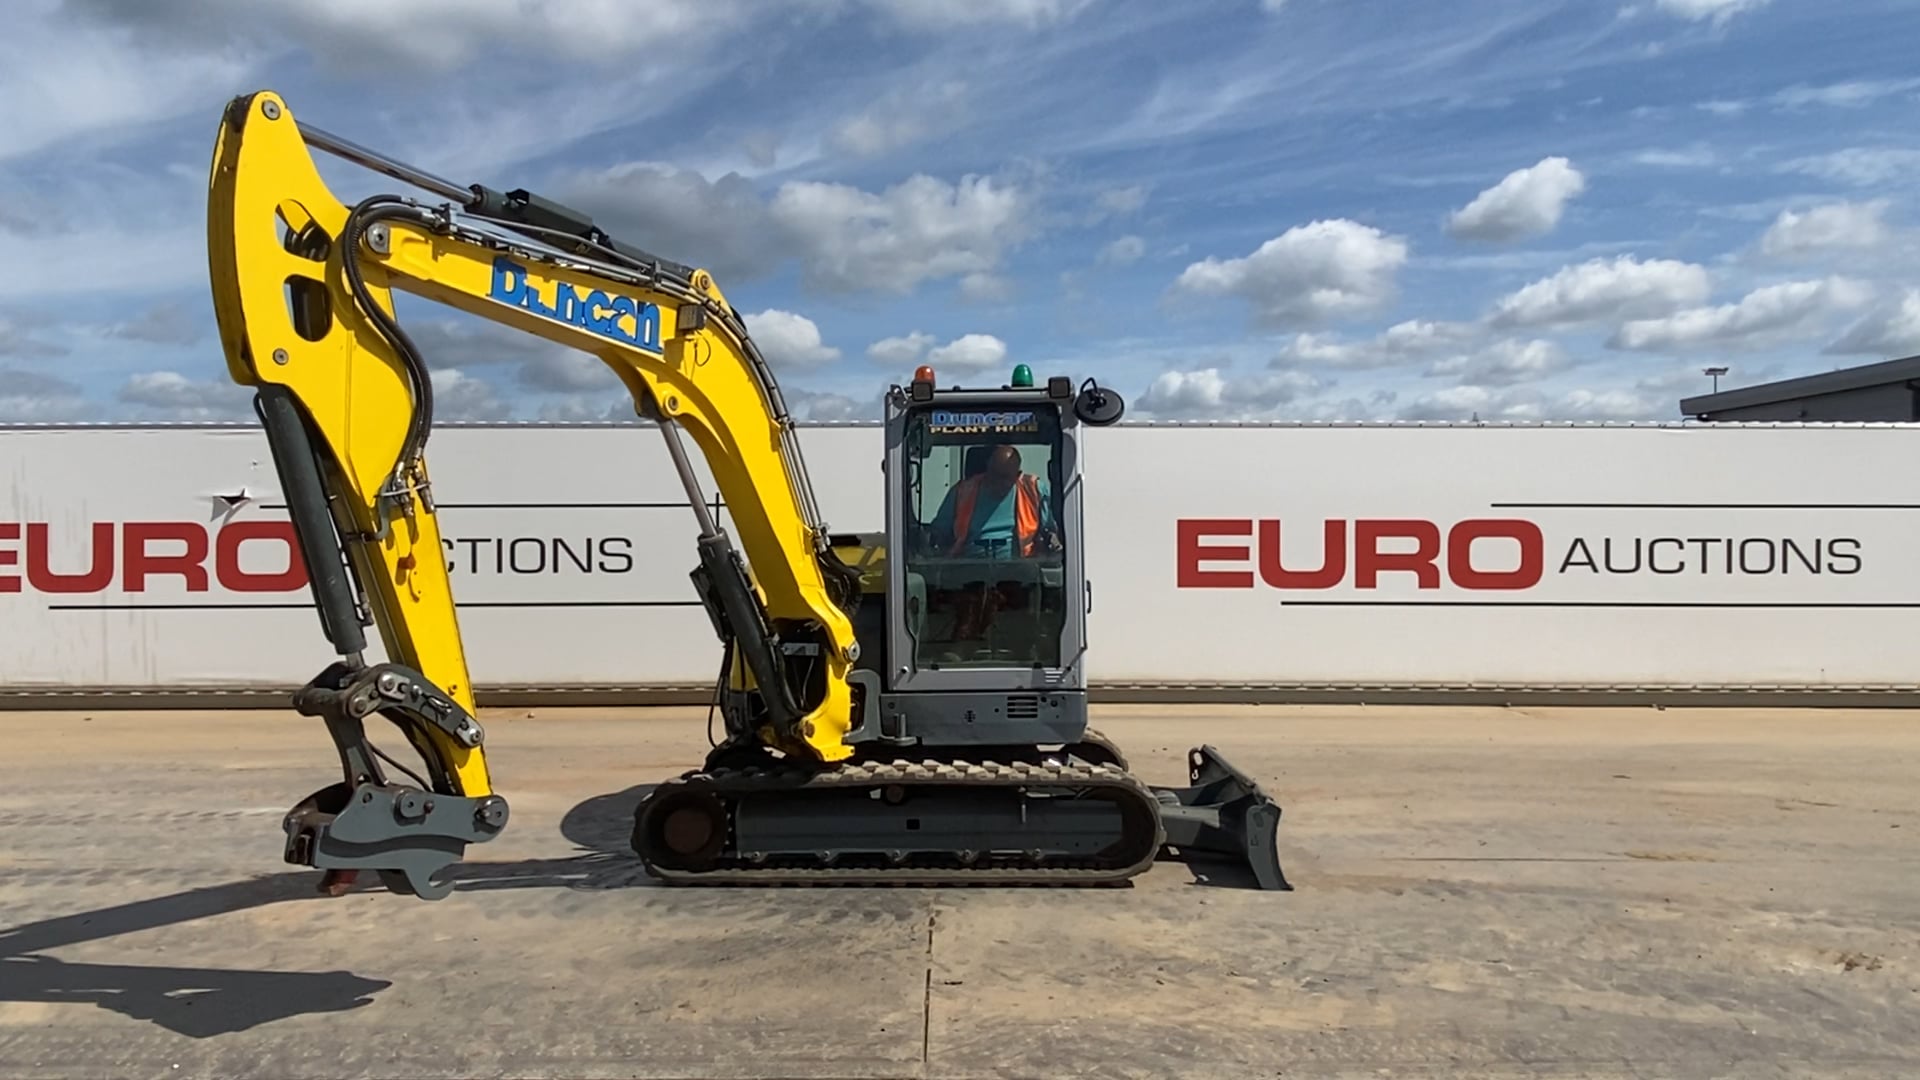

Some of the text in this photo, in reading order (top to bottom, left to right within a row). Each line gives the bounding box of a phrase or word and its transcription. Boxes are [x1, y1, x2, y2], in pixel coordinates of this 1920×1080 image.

[930, 425, 990, 433] PLANT
[932, 410, 1036, 425] Duncan
[0, 522, 310, 593] URO
[1177, 519, 1862, 590] EURO AUCTIONS
